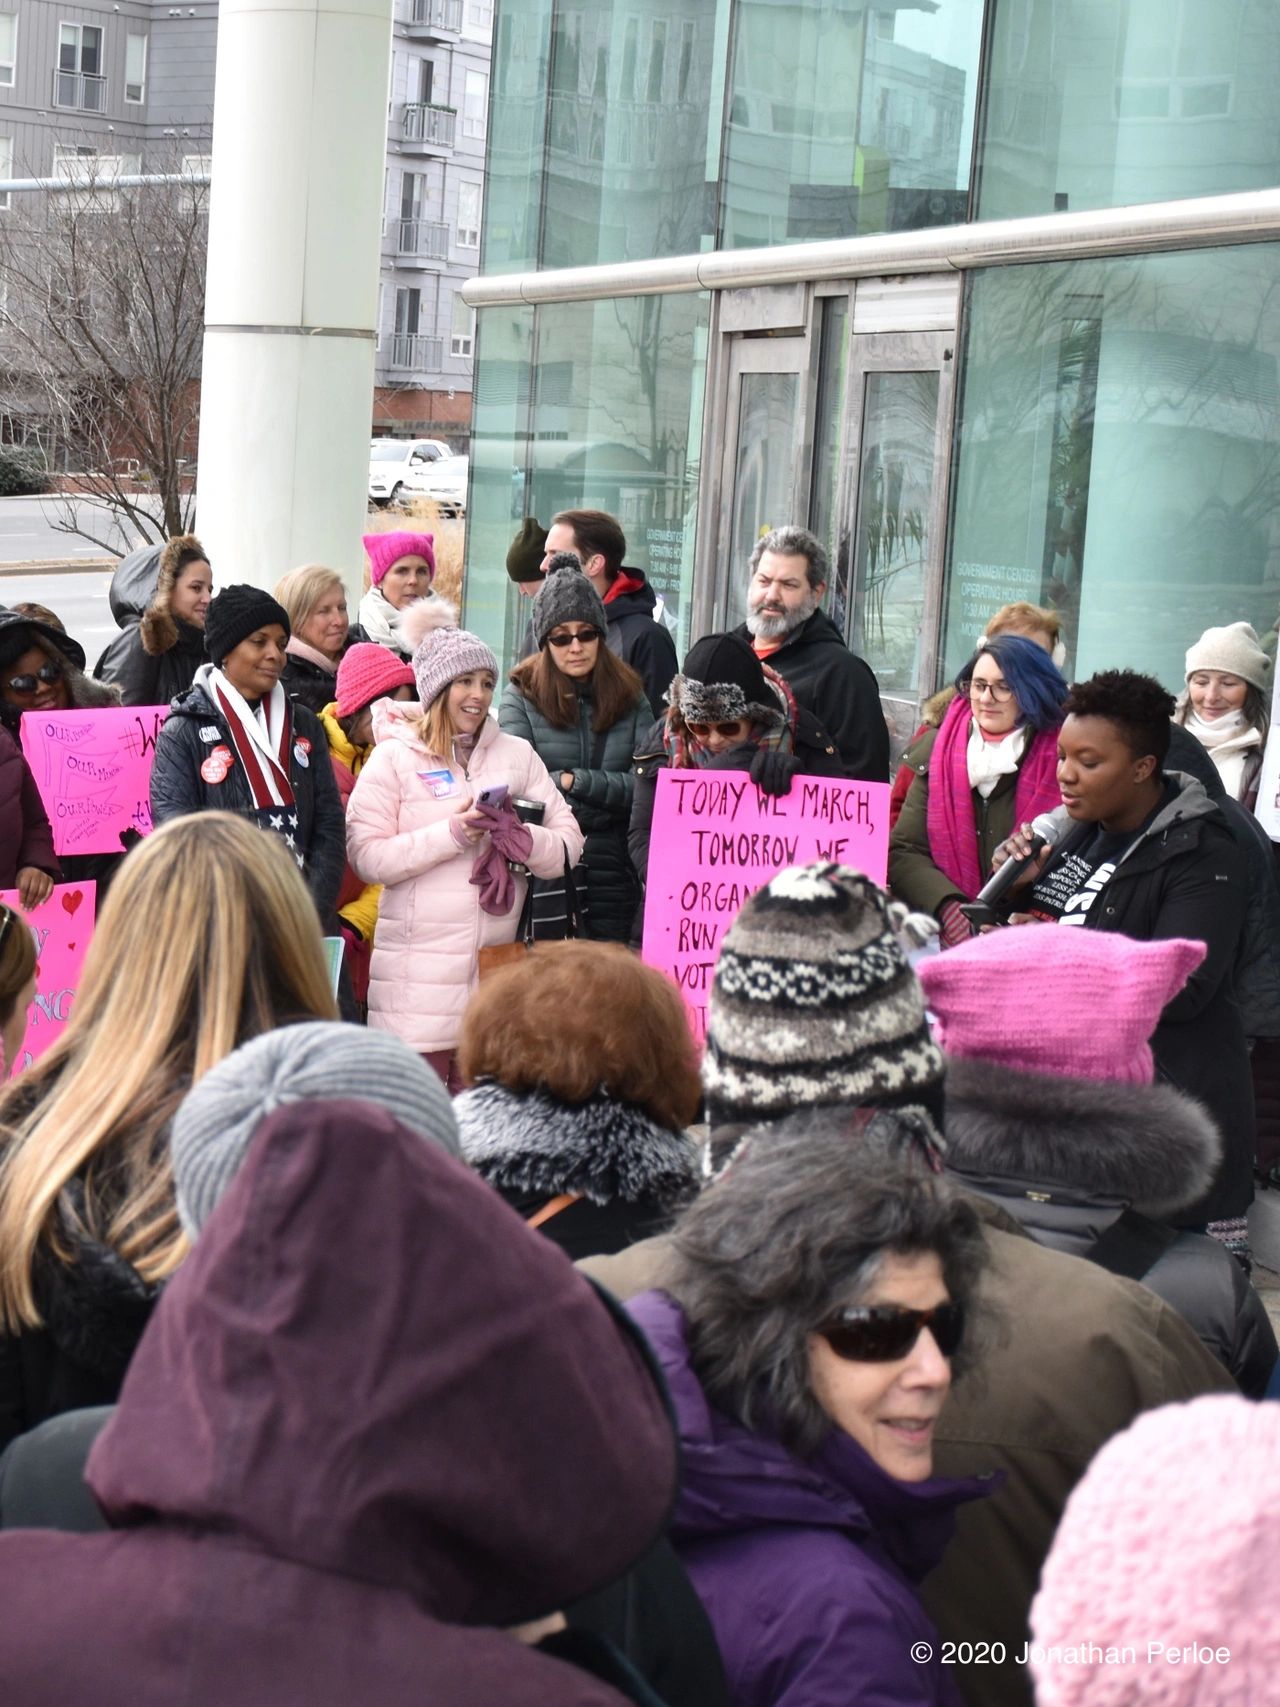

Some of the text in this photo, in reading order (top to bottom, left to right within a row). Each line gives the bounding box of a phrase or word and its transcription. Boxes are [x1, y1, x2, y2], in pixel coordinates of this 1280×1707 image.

[957, 561, 1037, 583] GOVERNMENT CENTER
[961, 582, 1001, 600] OPERATING
[961, 622, 982, 638] MOND
[67, 756, 97, 776] OUR
[57, 801, 86, 818] OUR
[671, 779, 747, 822] TODAY
[801, 783, 874, 835] MARCH,
[691, 831, 849, 867] TOMORROW WE
[681, 881, 757, 912] ORGAN
[678, 918, 717, 952] RUN
[674, 962, 714, 990] VOT
